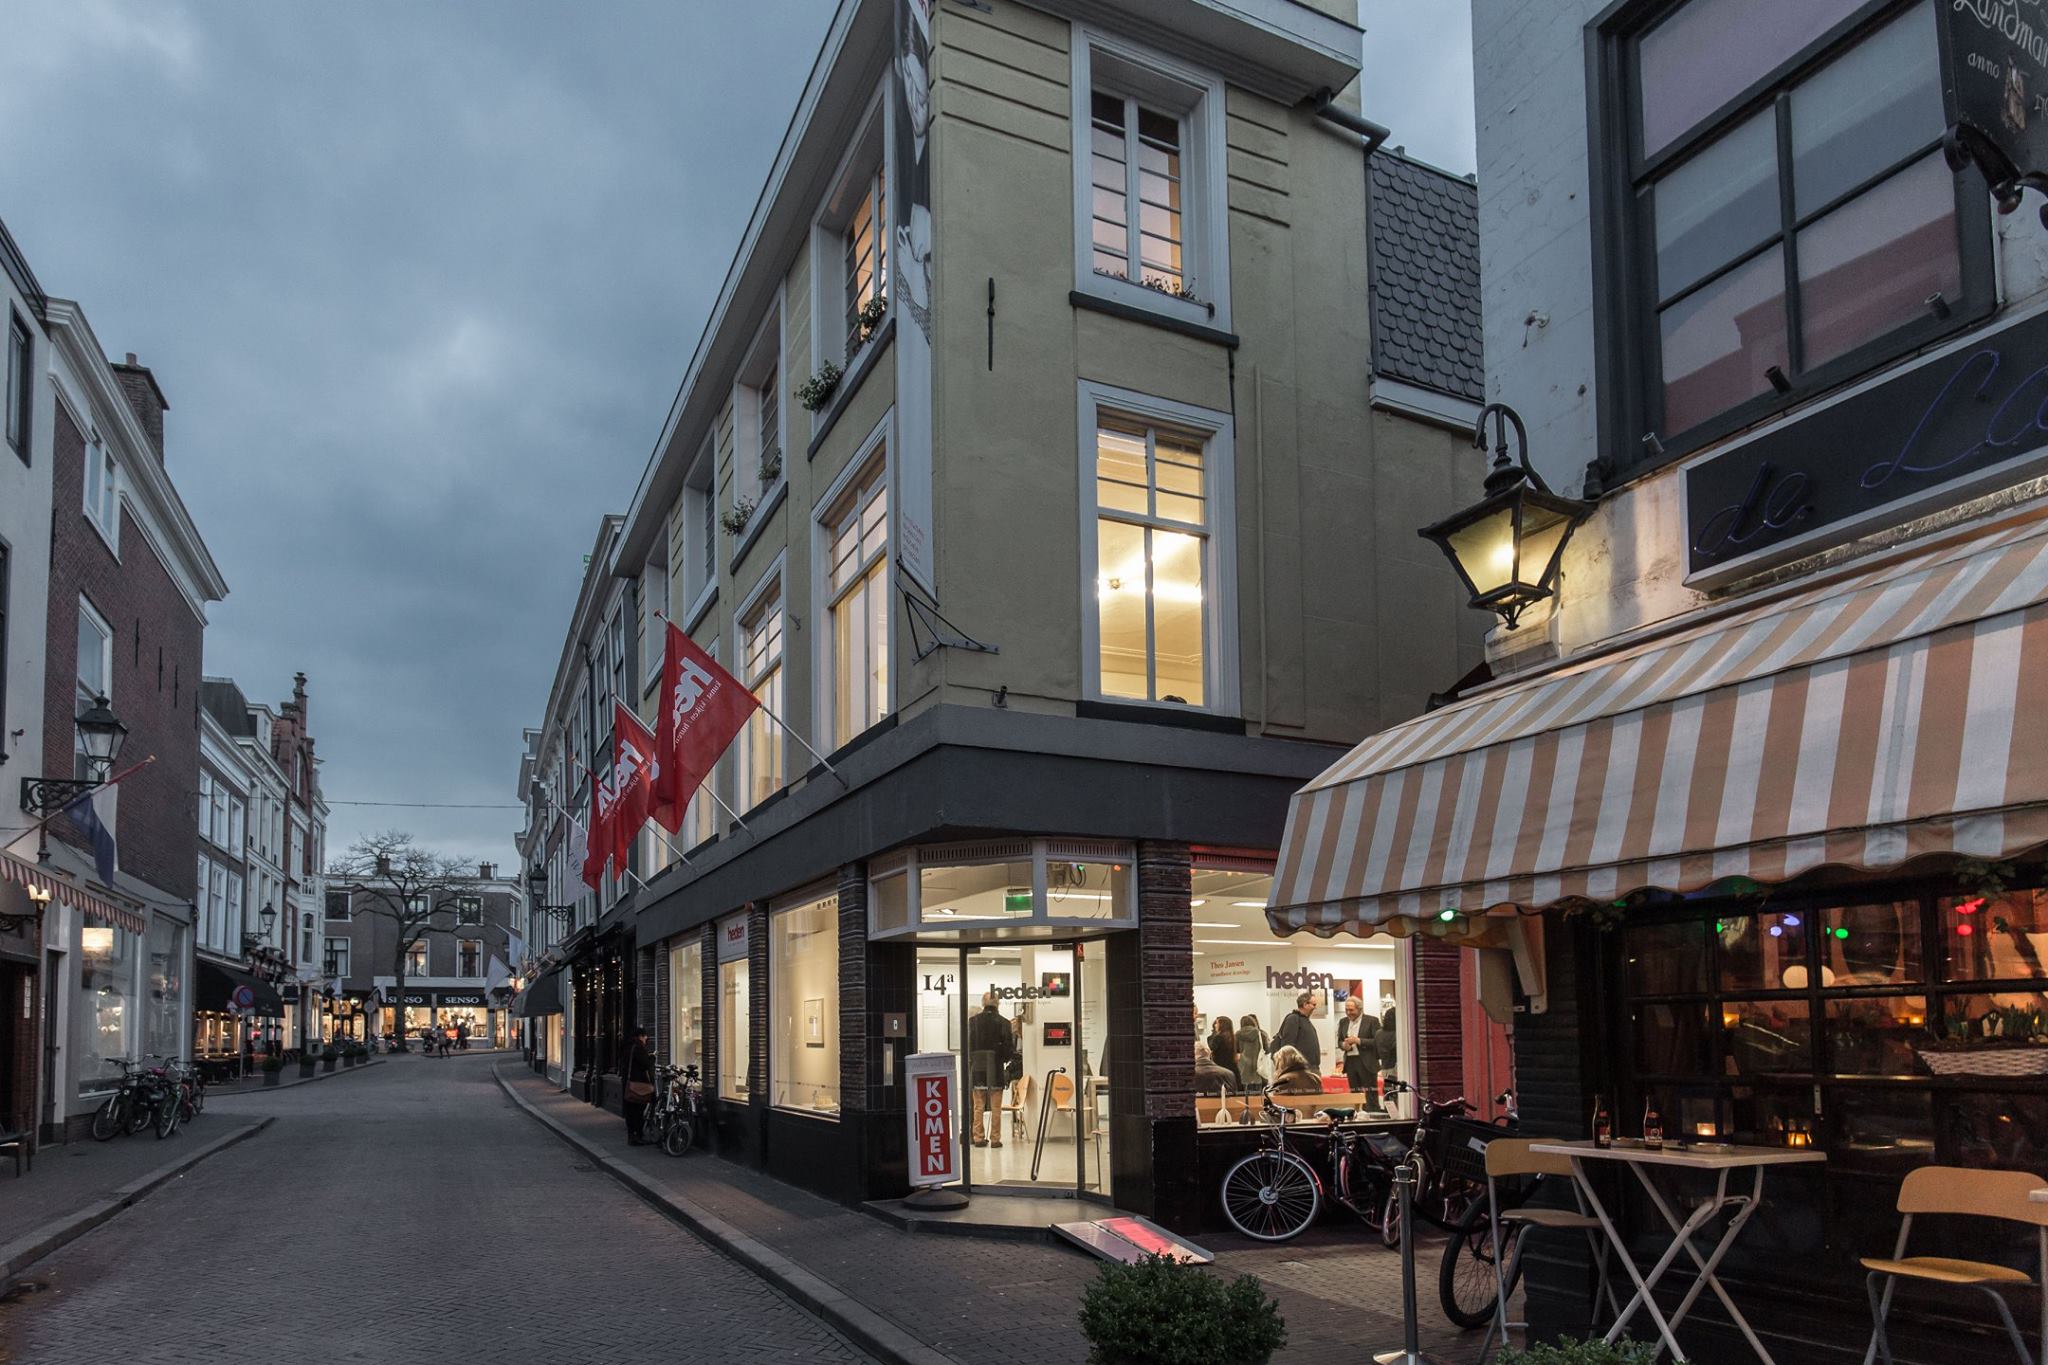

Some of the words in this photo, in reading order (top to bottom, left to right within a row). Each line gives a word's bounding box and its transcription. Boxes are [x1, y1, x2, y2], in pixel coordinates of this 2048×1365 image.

[1967, 52, 2000, 79] anno
[1694, 461, 1809, 554] de
[1266, 965, 1335, 990] heden
[445, 996, 480, 1004] SENSO
[990, 982, 1051, 1000] heden
[924, 1080, 945, 1172] KOMEN
